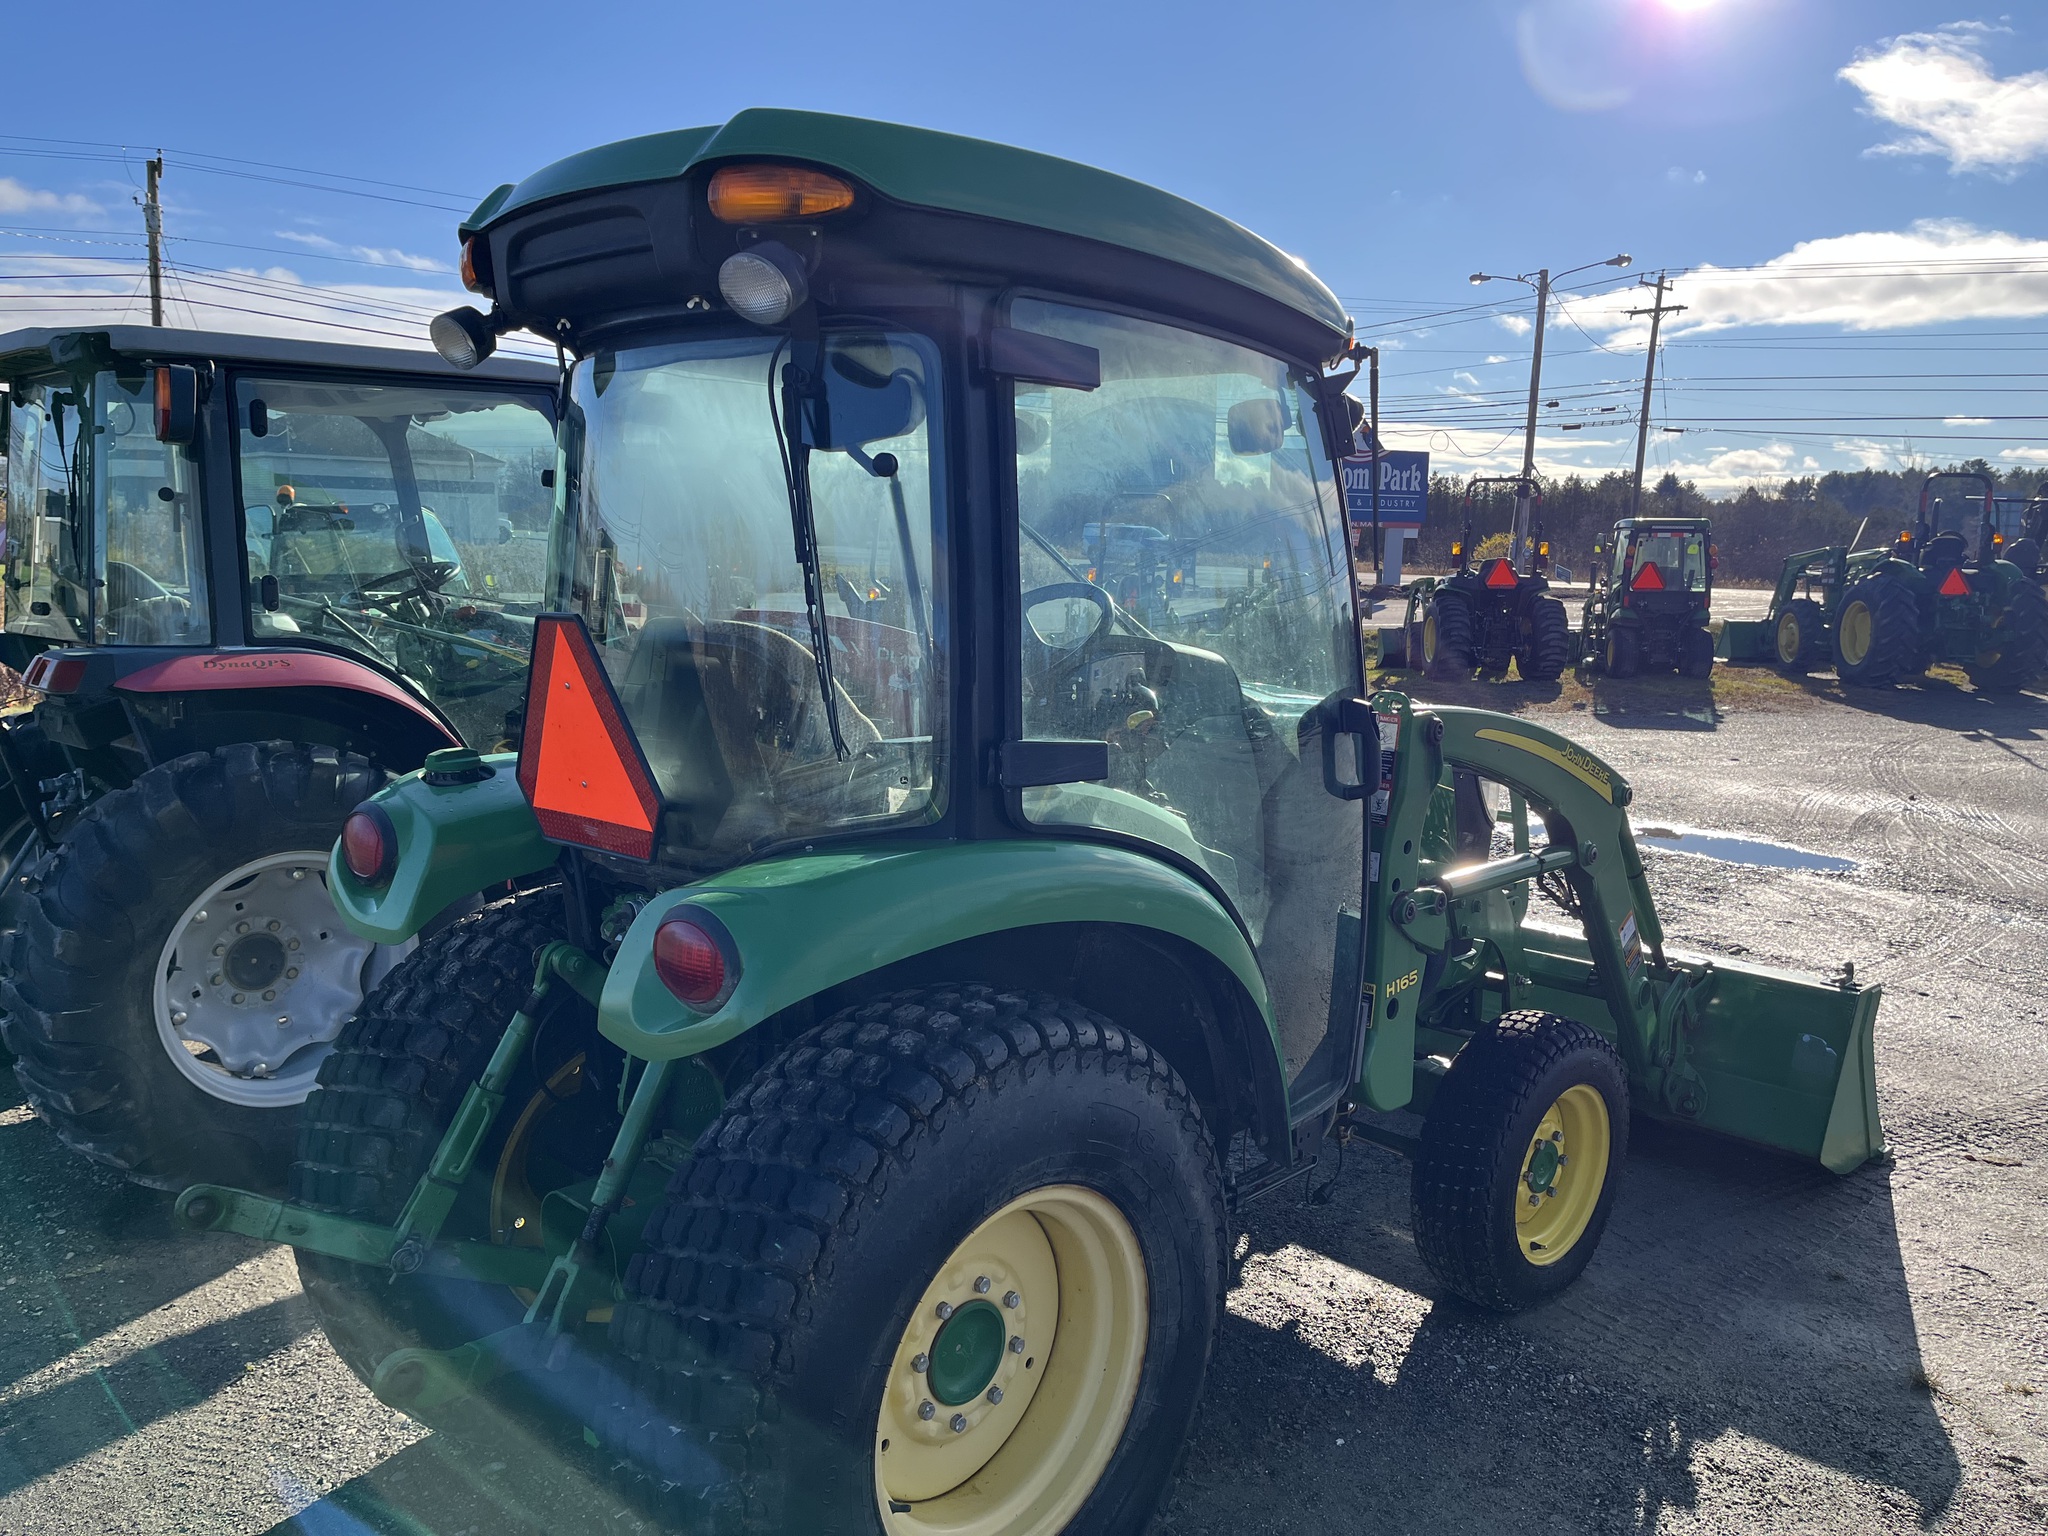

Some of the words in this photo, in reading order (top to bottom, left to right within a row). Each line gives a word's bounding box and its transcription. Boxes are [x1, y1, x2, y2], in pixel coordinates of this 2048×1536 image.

[1379, 462, 1421, 491] Park
[203, 659, 291, 670] DynaQPS
[1561, 743, 1586, 769] JOHN
[1583, 756, 1610, 785] DEERE
[1386, 969, 1418, 998] H165
